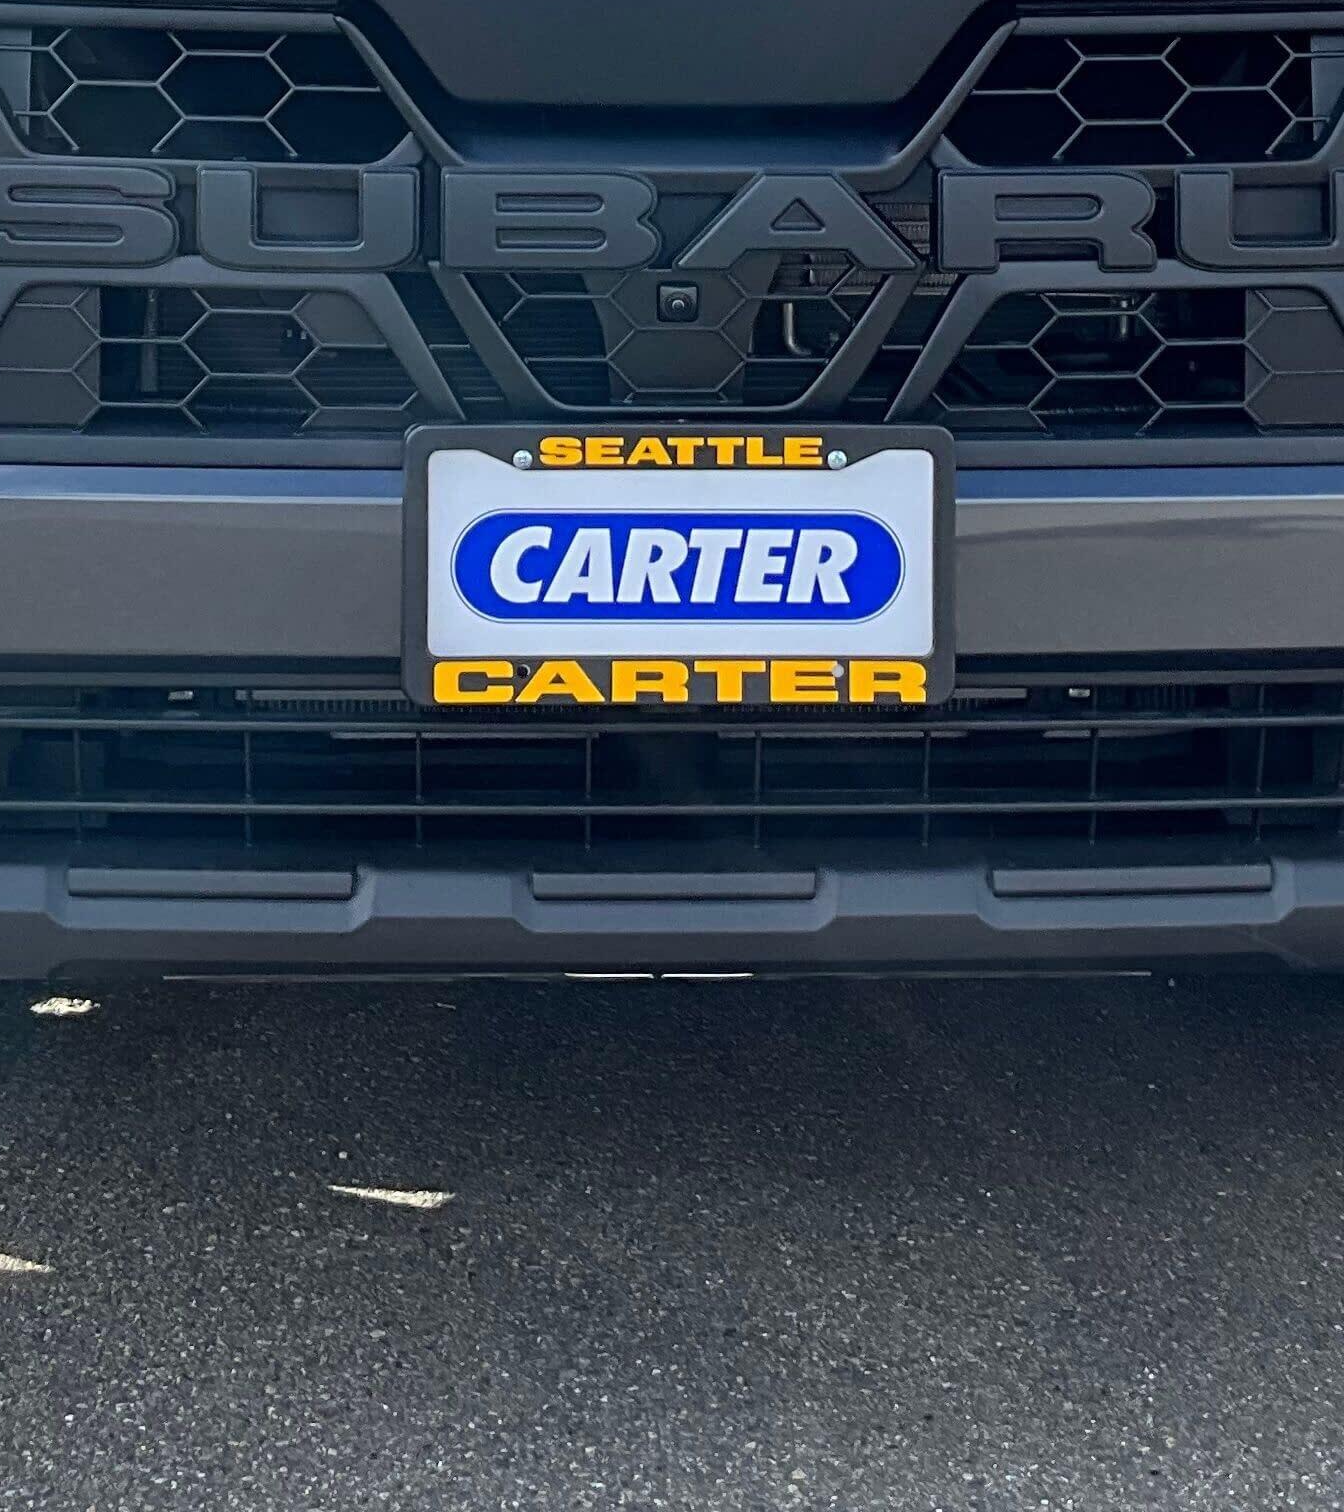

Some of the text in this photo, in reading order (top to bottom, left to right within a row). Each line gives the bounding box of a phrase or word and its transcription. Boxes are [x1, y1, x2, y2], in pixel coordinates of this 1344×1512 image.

[539, 436, 823, 465] SEATTLE
[490, 526, 858, 604] CARTER
[433, 660, 927, 703] CARTER
